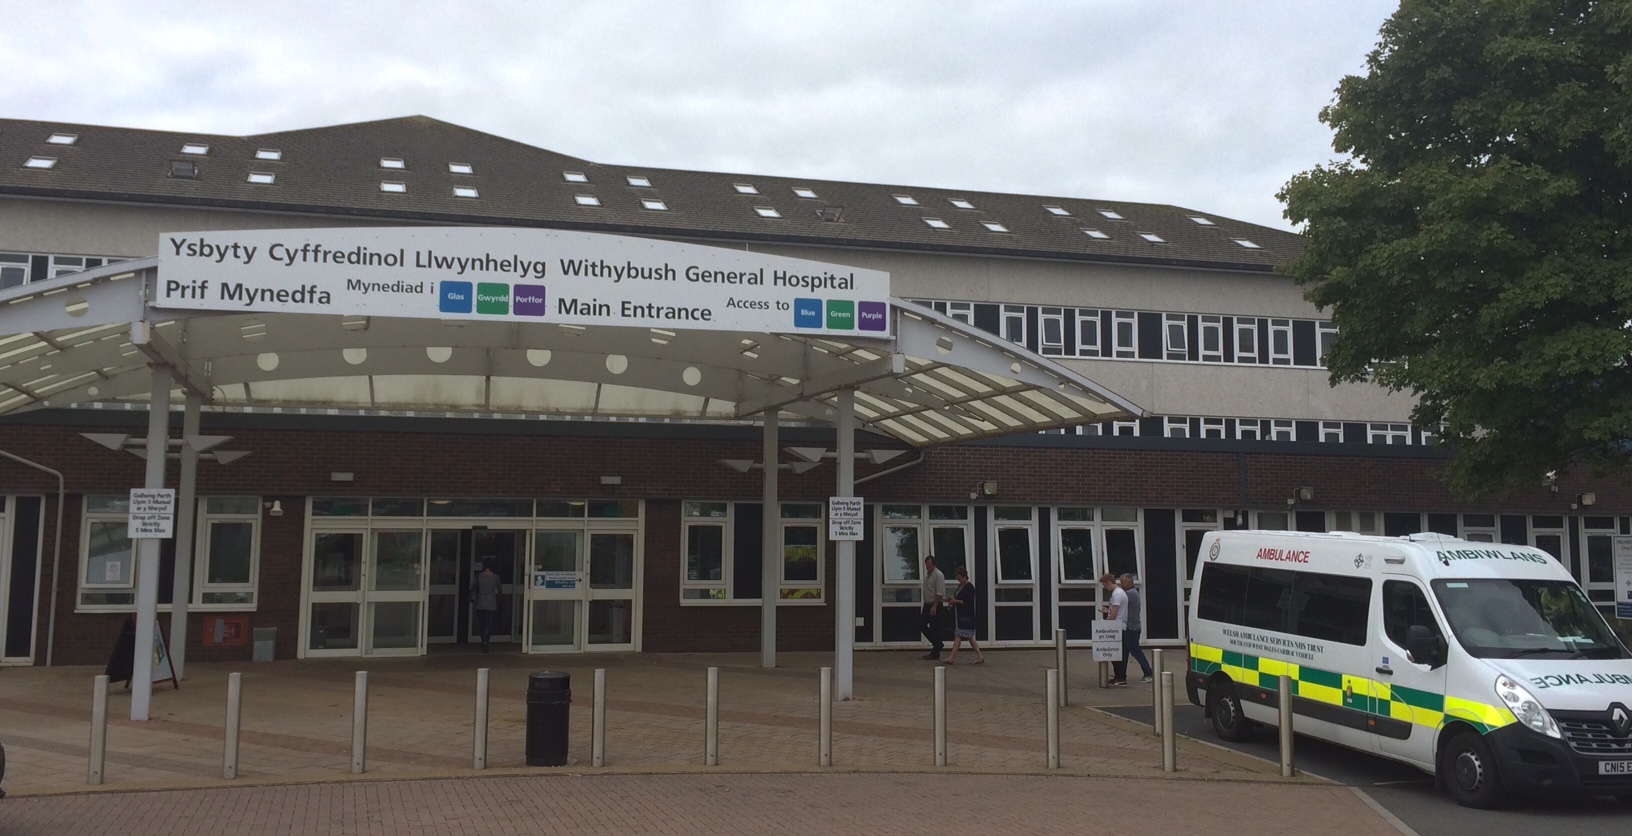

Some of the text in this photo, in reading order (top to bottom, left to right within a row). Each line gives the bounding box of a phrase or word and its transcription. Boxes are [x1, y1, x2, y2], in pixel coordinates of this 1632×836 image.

[170, 237, 547, 279] Ysbyty Cyffredinol Llwynhelyg
[559, 258, 854, 293] Withybush General Hospital
[165, 279, 332, 307] Prif Mynedfa
[346, 278, 435, 296] Mynediad i
[447, 292, 465, 300] Glas
[477, 294, 509, 303] Gwyrdd
[515, 295, 543, 304] Porffor
[557, 298, 712, 321] Main Entrance
[726, 297, 790, 312] Access to
[830, 310, 851, 318] Green
[861, 311, 883, 320] Purple
[1256, 547, 1311, 563] AMBULANCE
[1436, 549, 1548, 565] AMBIWLANS
[1222, 628, 1324, 654] WELSH AMBULANCE SERVICES NHS TRUST
[1604, 762, 1625, 773] CN15
